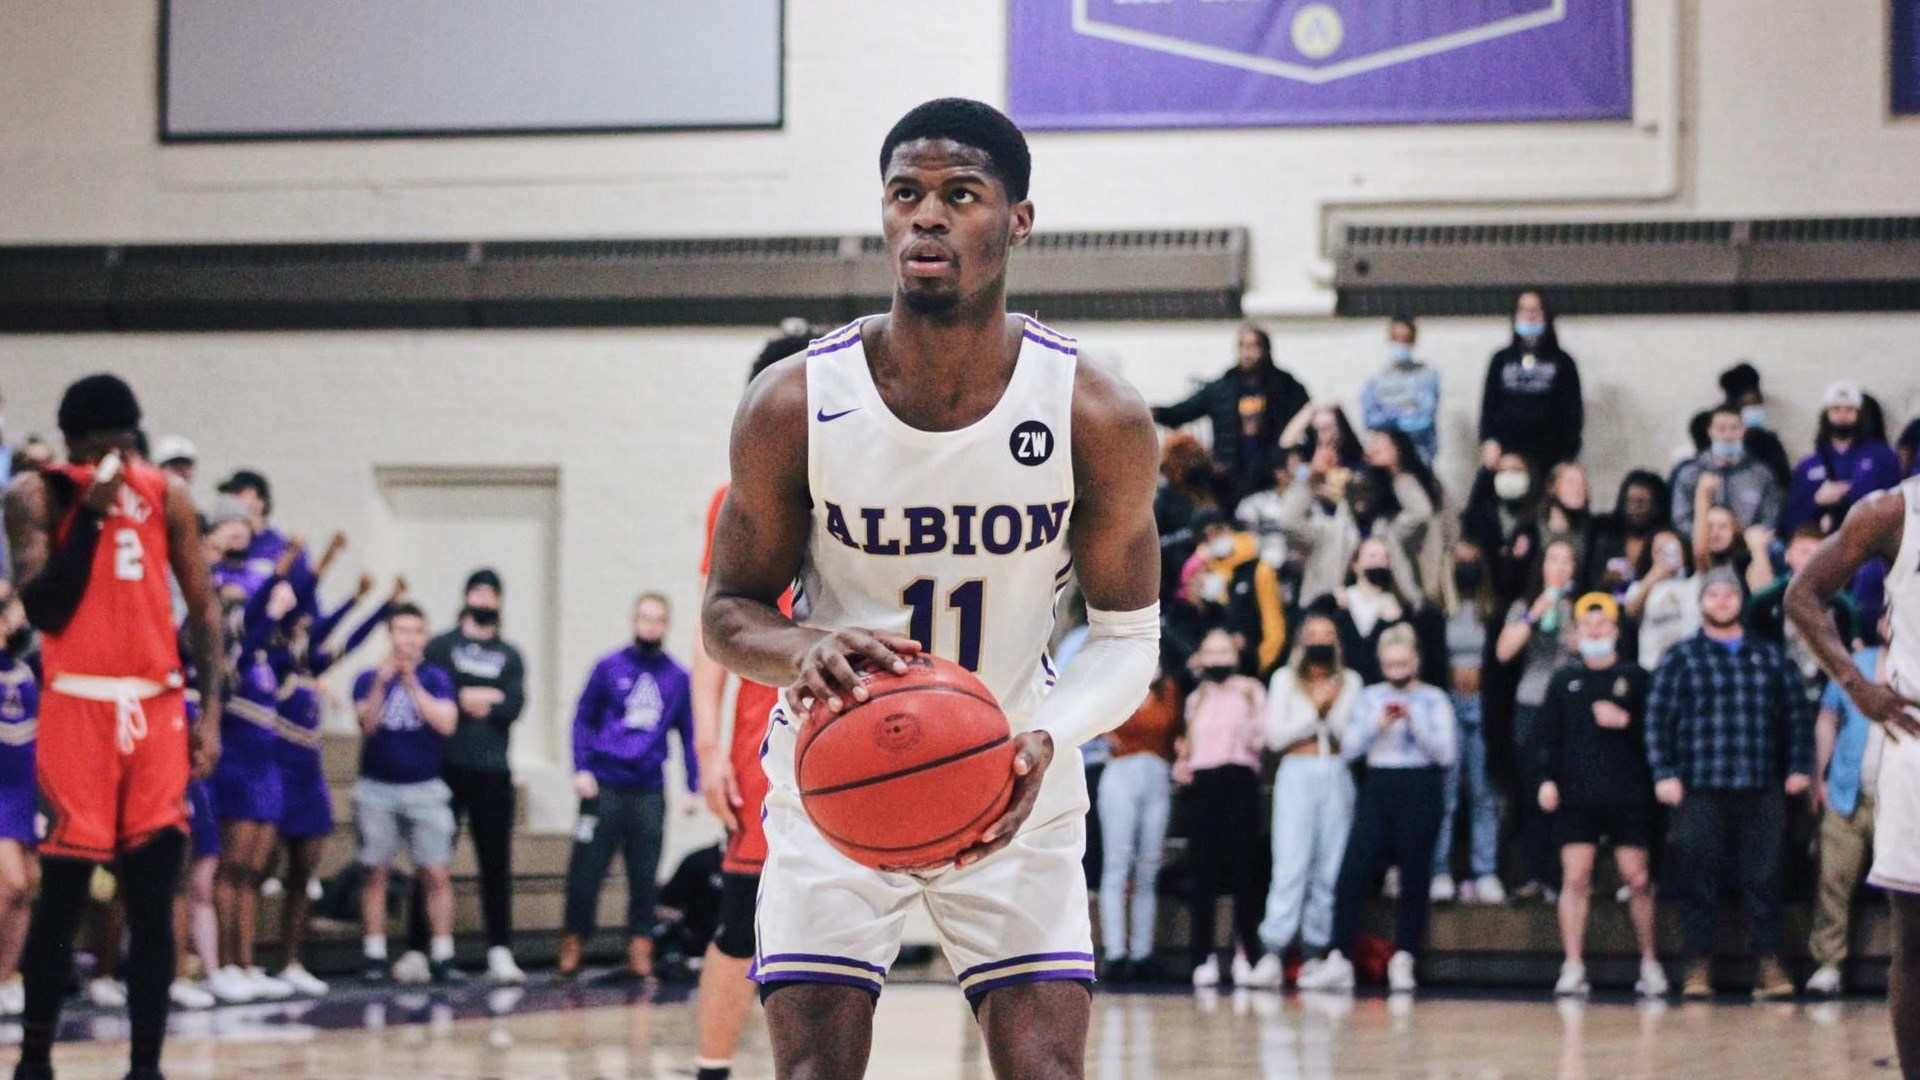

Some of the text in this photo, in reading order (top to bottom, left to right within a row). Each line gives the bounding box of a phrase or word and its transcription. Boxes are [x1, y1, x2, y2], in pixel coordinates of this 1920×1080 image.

[1017, 431, 1047, 458] ZW
[114, 528, 145, 581] 2
[823, 500, 1071, 556] ALBION
[900, 574, 988, 674] 11
